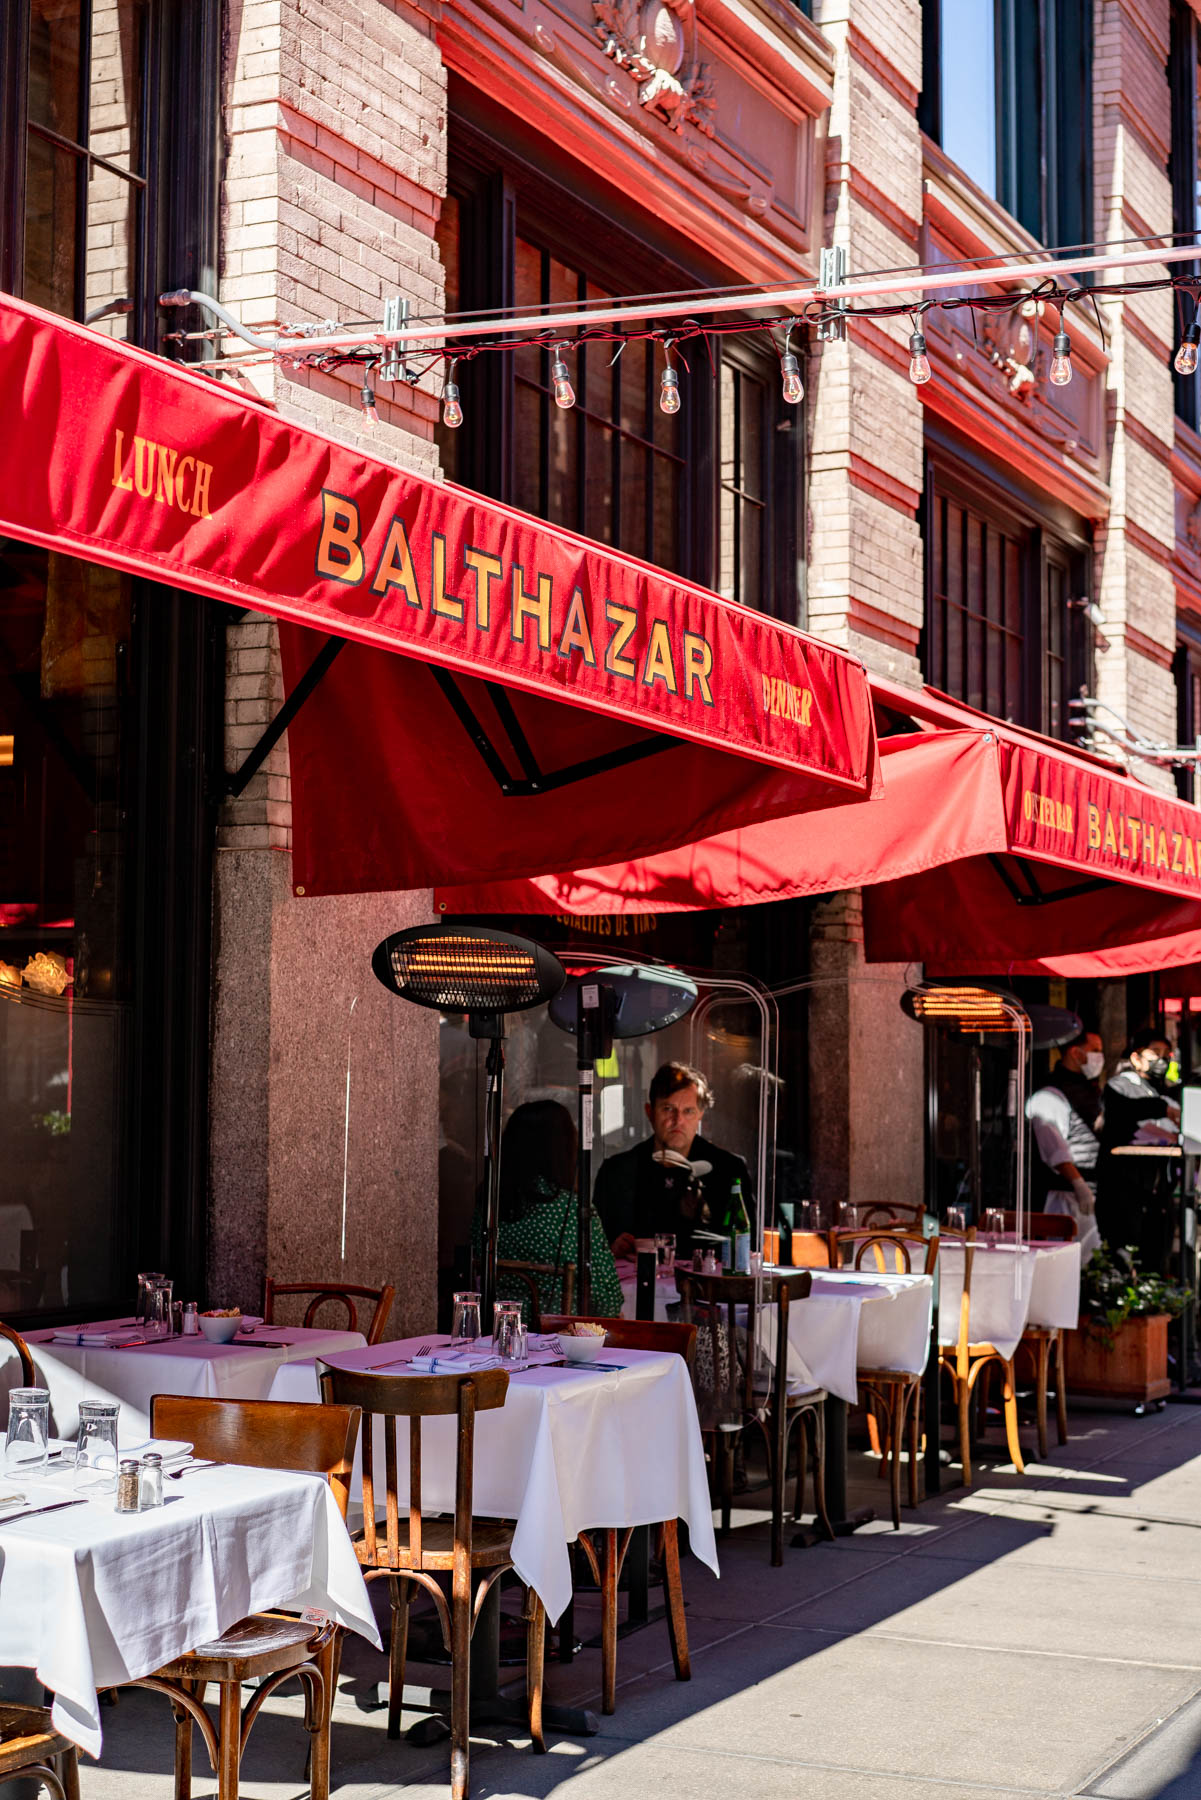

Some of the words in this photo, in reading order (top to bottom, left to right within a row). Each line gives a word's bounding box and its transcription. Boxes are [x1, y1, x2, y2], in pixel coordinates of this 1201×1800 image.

[112, 428, 214, 520] LUNCH
[315, 487, 715, 707] BALTHAZAR
[762, 673, 812, 727] DINNER
